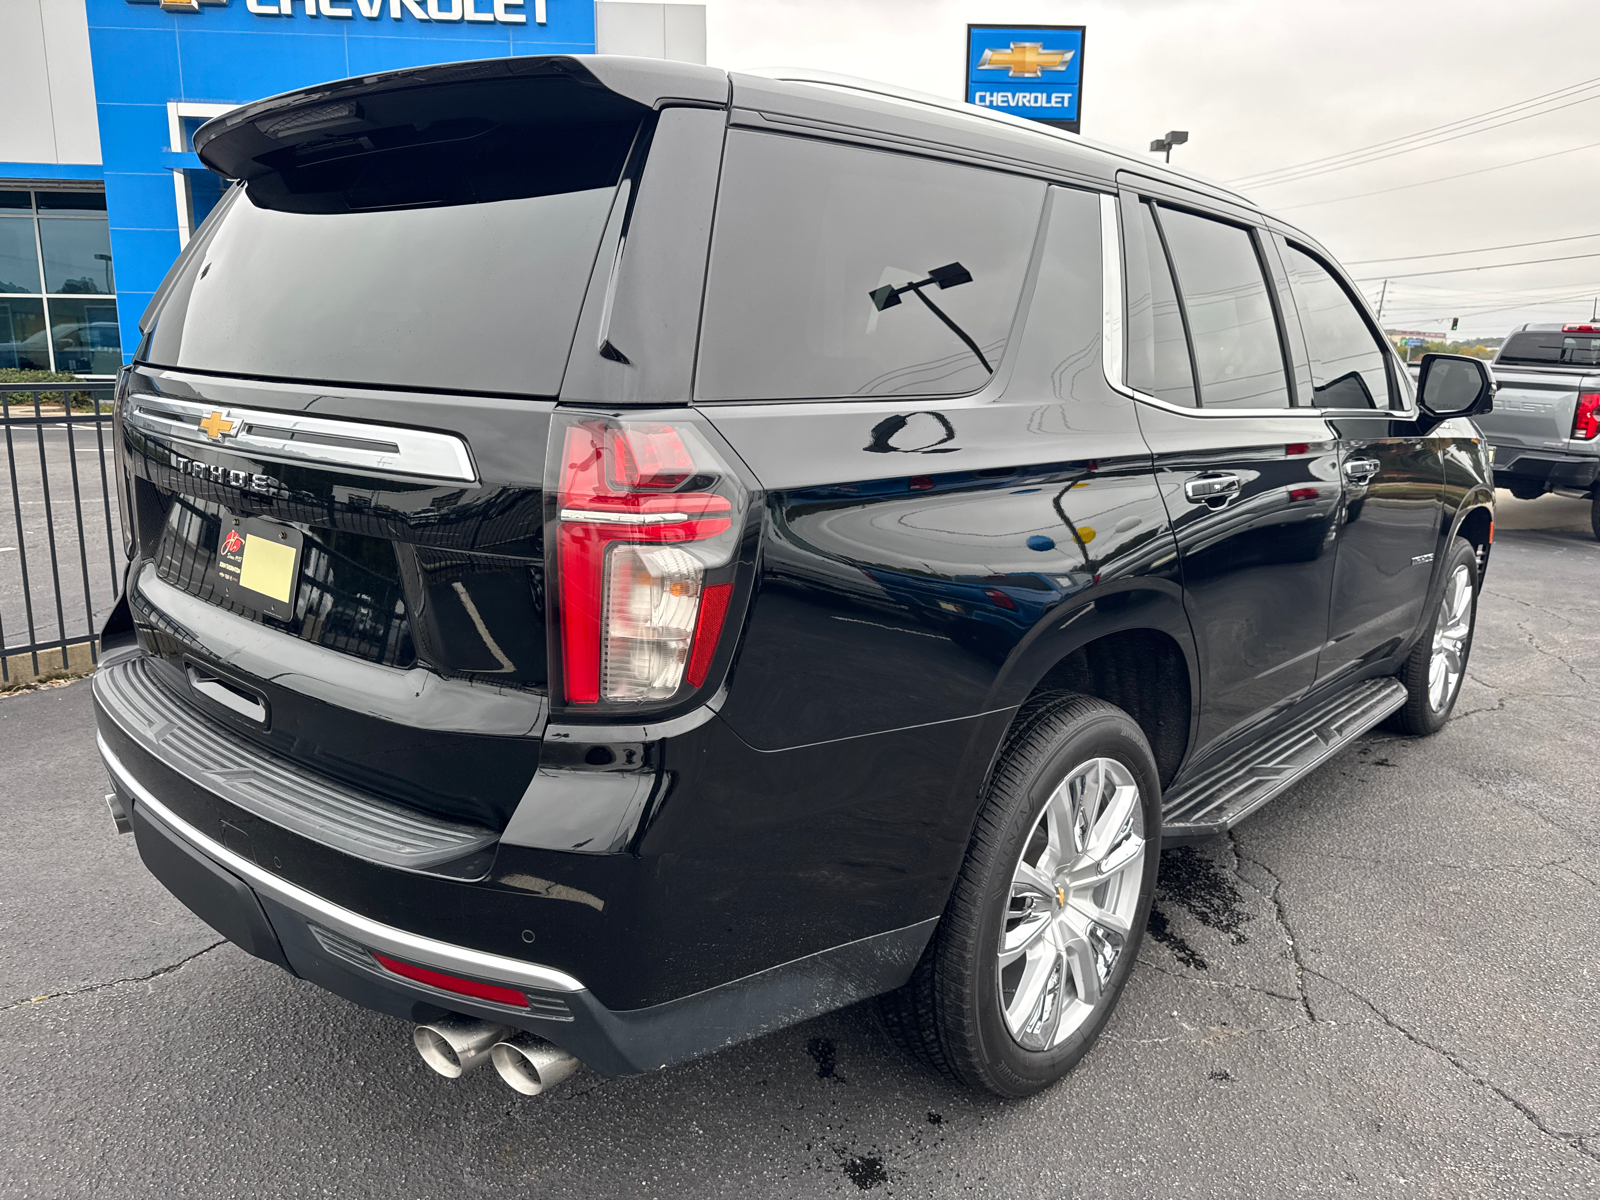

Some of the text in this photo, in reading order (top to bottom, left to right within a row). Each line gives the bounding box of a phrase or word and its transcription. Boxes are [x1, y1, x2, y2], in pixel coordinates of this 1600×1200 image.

[975, 91, 1073, 108] CHEVROLET
[177, 456, 270, 491] TAHOE
[995, 809, 1028, 881] ALENZA
